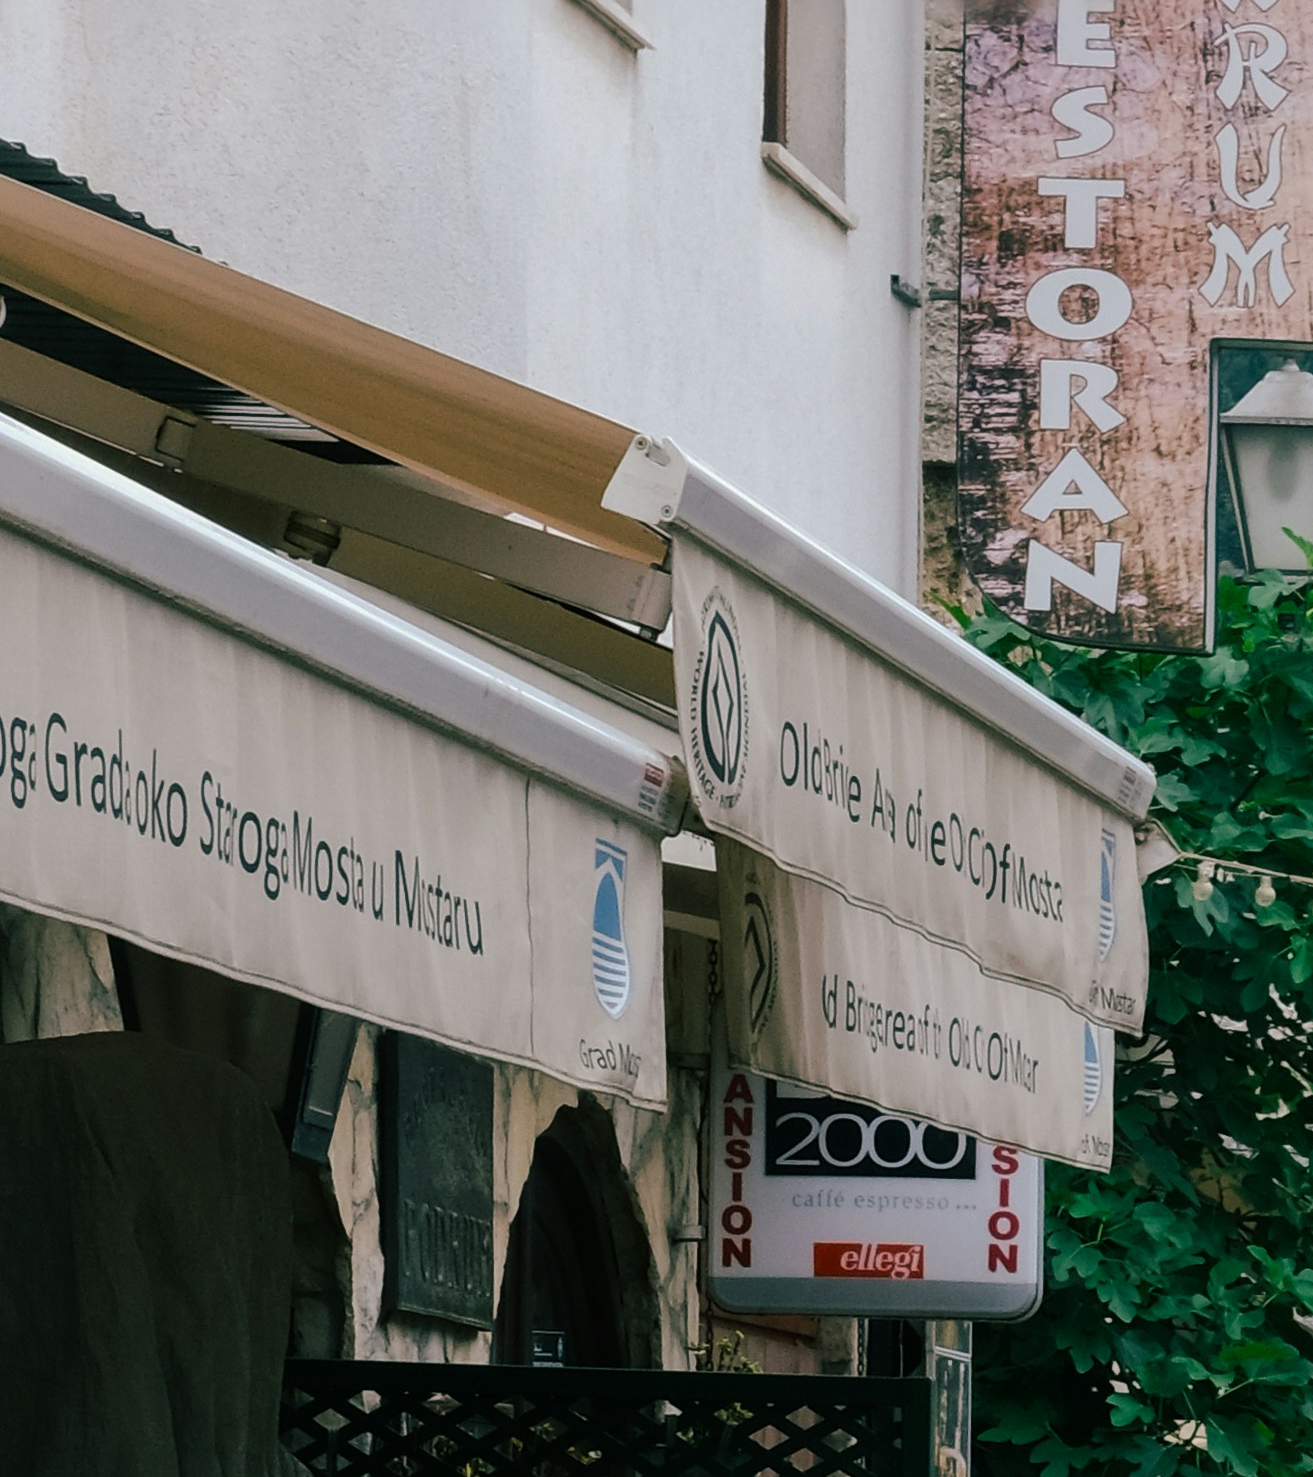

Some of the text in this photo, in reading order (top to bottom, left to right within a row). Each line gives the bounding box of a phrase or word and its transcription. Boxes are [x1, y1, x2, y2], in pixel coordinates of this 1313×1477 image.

[775, 1112, 967, 1170] 2000
[792, 1189, 845, 1209] caffé
[840, 1242, 921, 1279] ellegi
